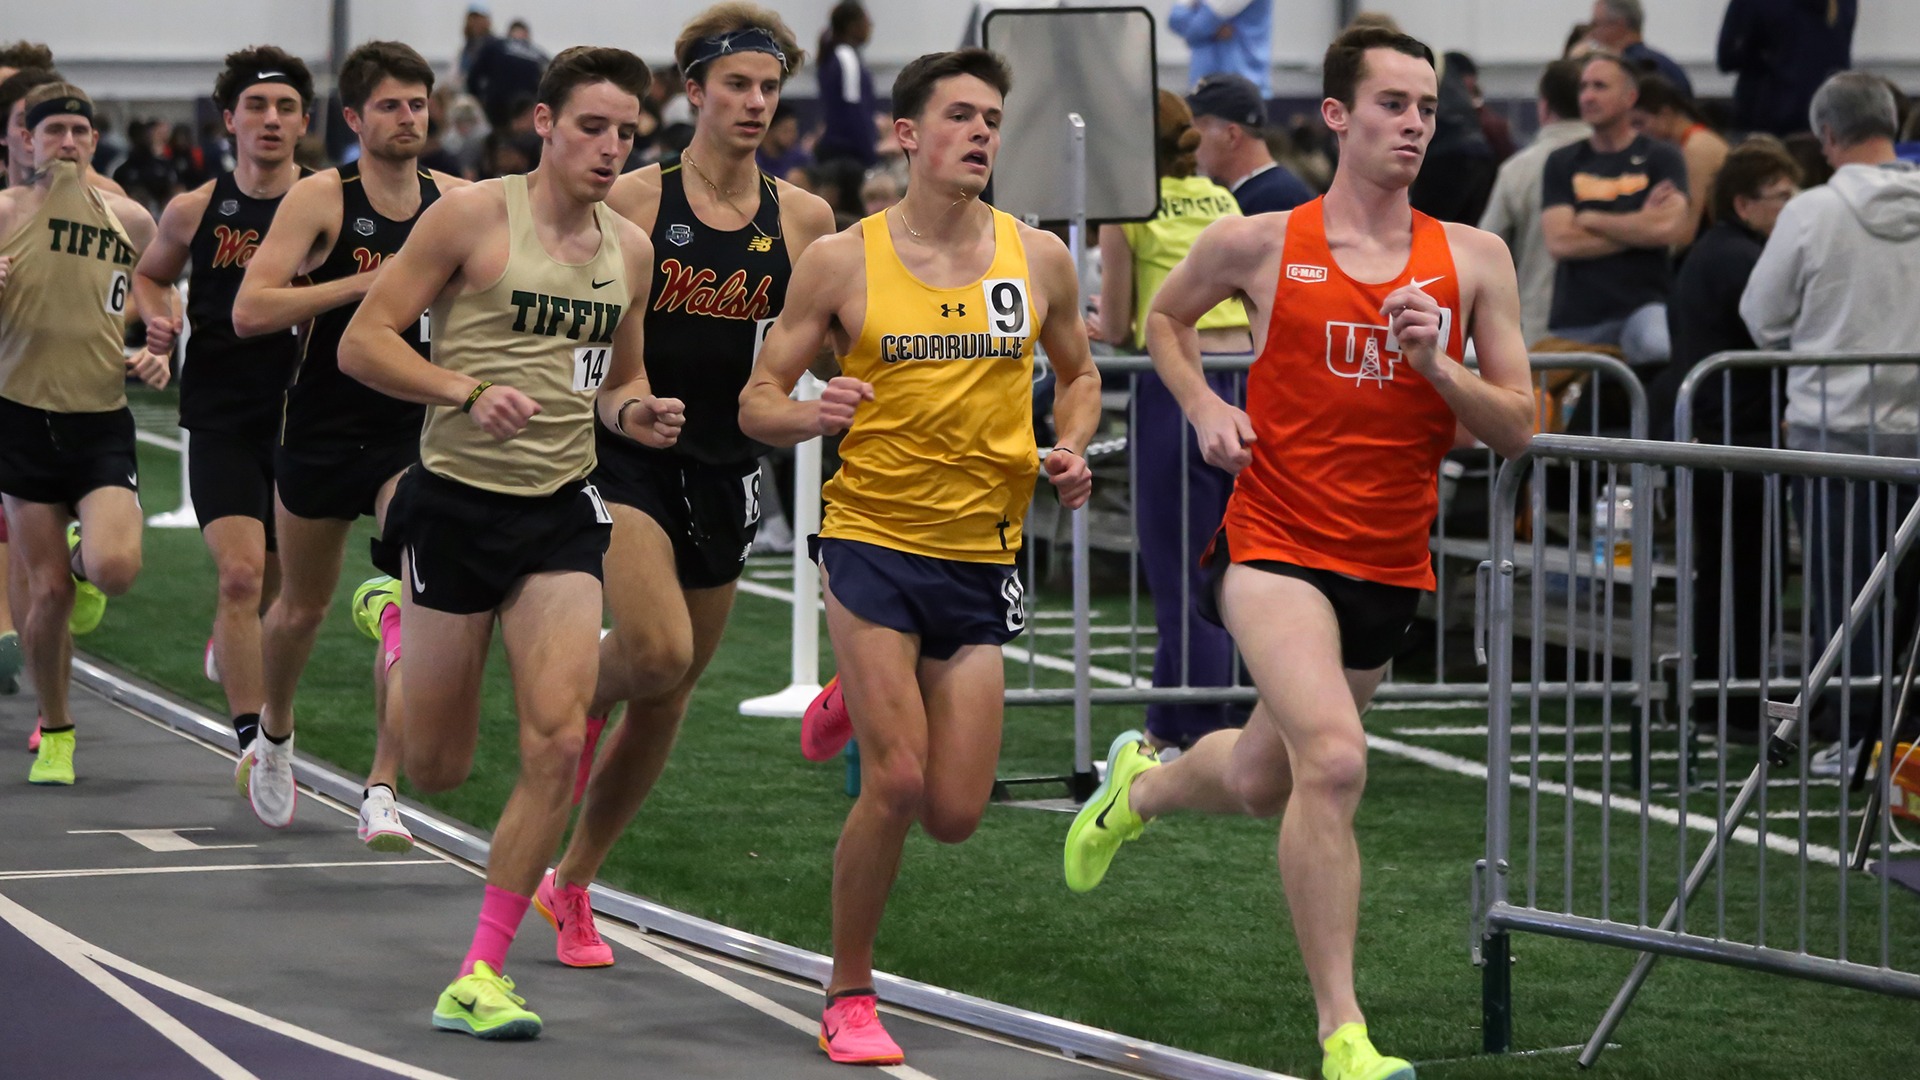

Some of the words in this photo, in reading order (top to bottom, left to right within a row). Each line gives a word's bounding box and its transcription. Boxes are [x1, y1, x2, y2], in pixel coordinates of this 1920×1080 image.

[111, 275, 127, 312] 6
[653, 258, 772, 322] Walsh
[1290, 266, 1323, 278] G-MAC
[511, 290, 622, 344] TIFFIN
[991, 282, 1024, 333] 9
[582, 349, 606, 388] 14
[880, 332, 1027, 363] CEDARVILLE
[751, 473, 761, 521] 8
[1004, 575, 1024, 626] 9
